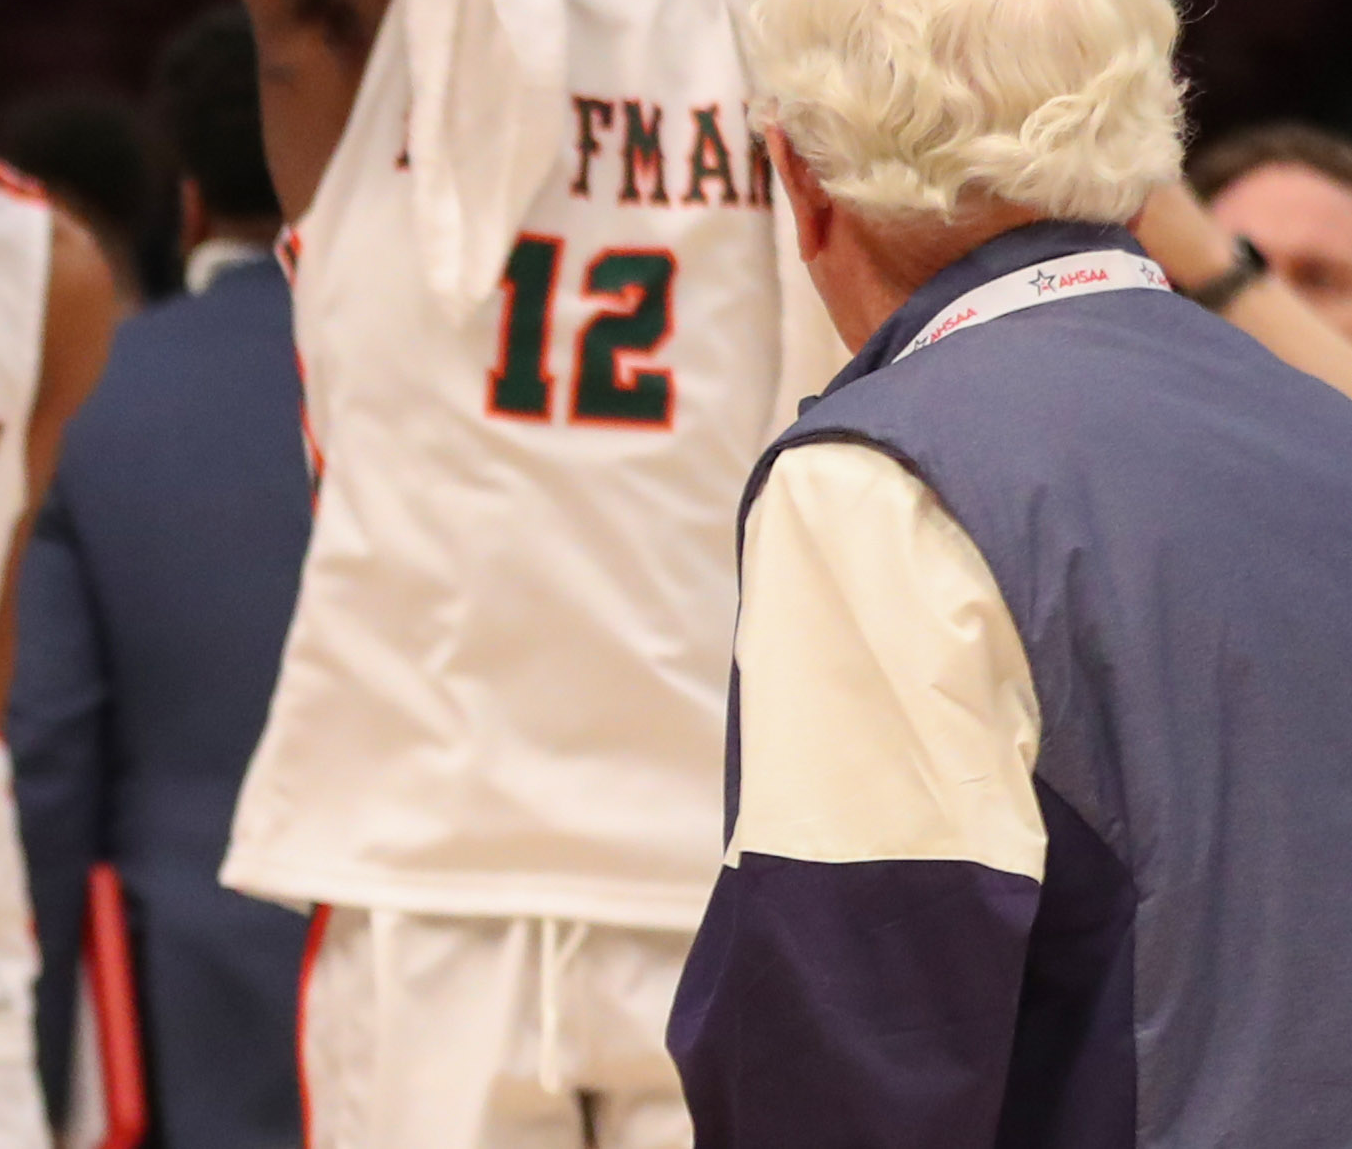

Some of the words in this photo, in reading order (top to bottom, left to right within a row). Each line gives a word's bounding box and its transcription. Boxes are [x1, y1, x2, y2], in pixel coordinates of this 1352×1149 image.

[569, 92, 773, 210] FMAN
[484, 232, 679, 434] 12
[1059, 268, 1109, 288] AHSAA
